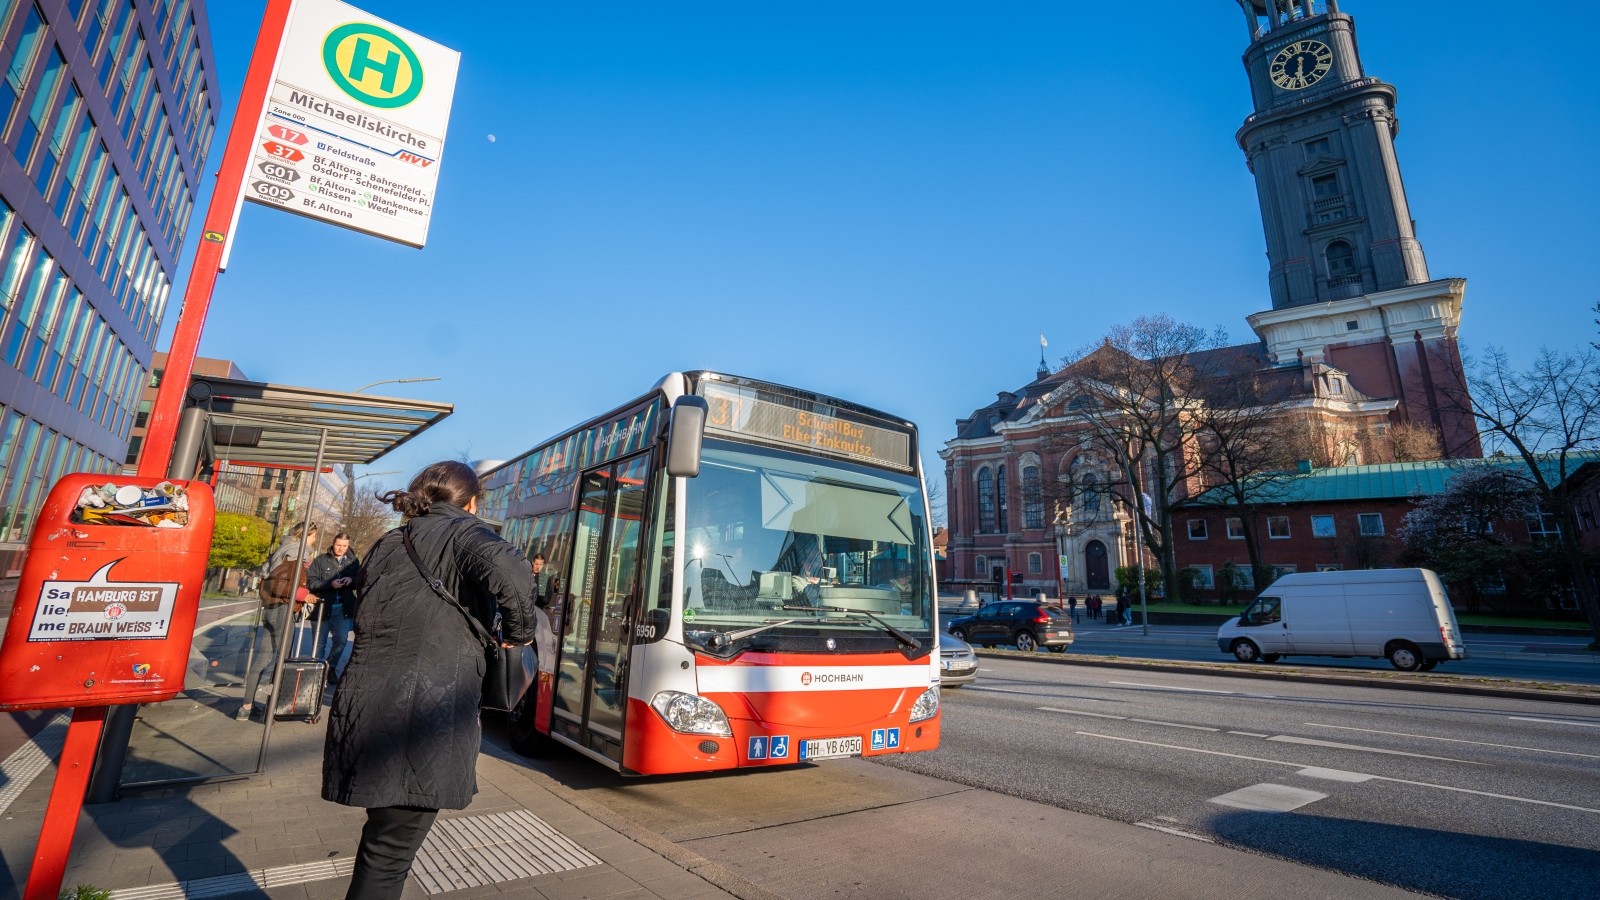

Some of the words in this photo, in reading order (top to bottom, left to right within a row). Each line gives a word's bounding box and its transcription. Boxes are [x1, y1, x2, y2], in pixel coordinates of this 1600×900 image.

[348, 37, 401, 94] H
[273, 107, 291, 117] Zone
[292, 113, 306, 122] 000
[289, 91, 427, 150] Michaeliskirche
[281, 128, 300, 142] 17
[273, 144, 295, 159] 37
[326, 145, 376, 167] Feldstraße
[399, 152, 432, 168] HVV
[264, 164, 294, 181] 601
[313, 155, 327, 166] Bf.
[328, 161, 362, 177] Altona
[370, 174, 421, 196] Bahrenfeld
[257, 183, 290, 199] 609
[312, 164, 348, 181] Osdorf
[355, 177, 417, 203] Schenefelder
[418, 198, 430, 207] Pl.
[310, 175, 323, 185] Bf.
[324, 180, 357, 196] Altona
[372, 195, 424, 216] Blankenese
[318, 186, 351, 202] Rissen
[368, 201, 397, 217] Wedel
[303, 198, 317, 208] Bf.
[318, 203, 353, 219] Altona
[711, 393, 743, 429] 37
[601, 420, 645, 447] HOCHBAHN
[798, 413, 863, 439] SchnellBus
[783, 424, 875, 456] Elbe-Einkaufsz.
[47, 589, 73, 600] Sa
[76, 590, 136, 602] HAMBURG
[68, 622, 113, 634] BRAUN
[636, 624, 656, 638] 6950
[814, 673, 864, 683] HOCHBAHN
[807, 742, 820, 756] HH
[826, 741, 837, 754] YB
[840, 739, 861, 753] 6950
